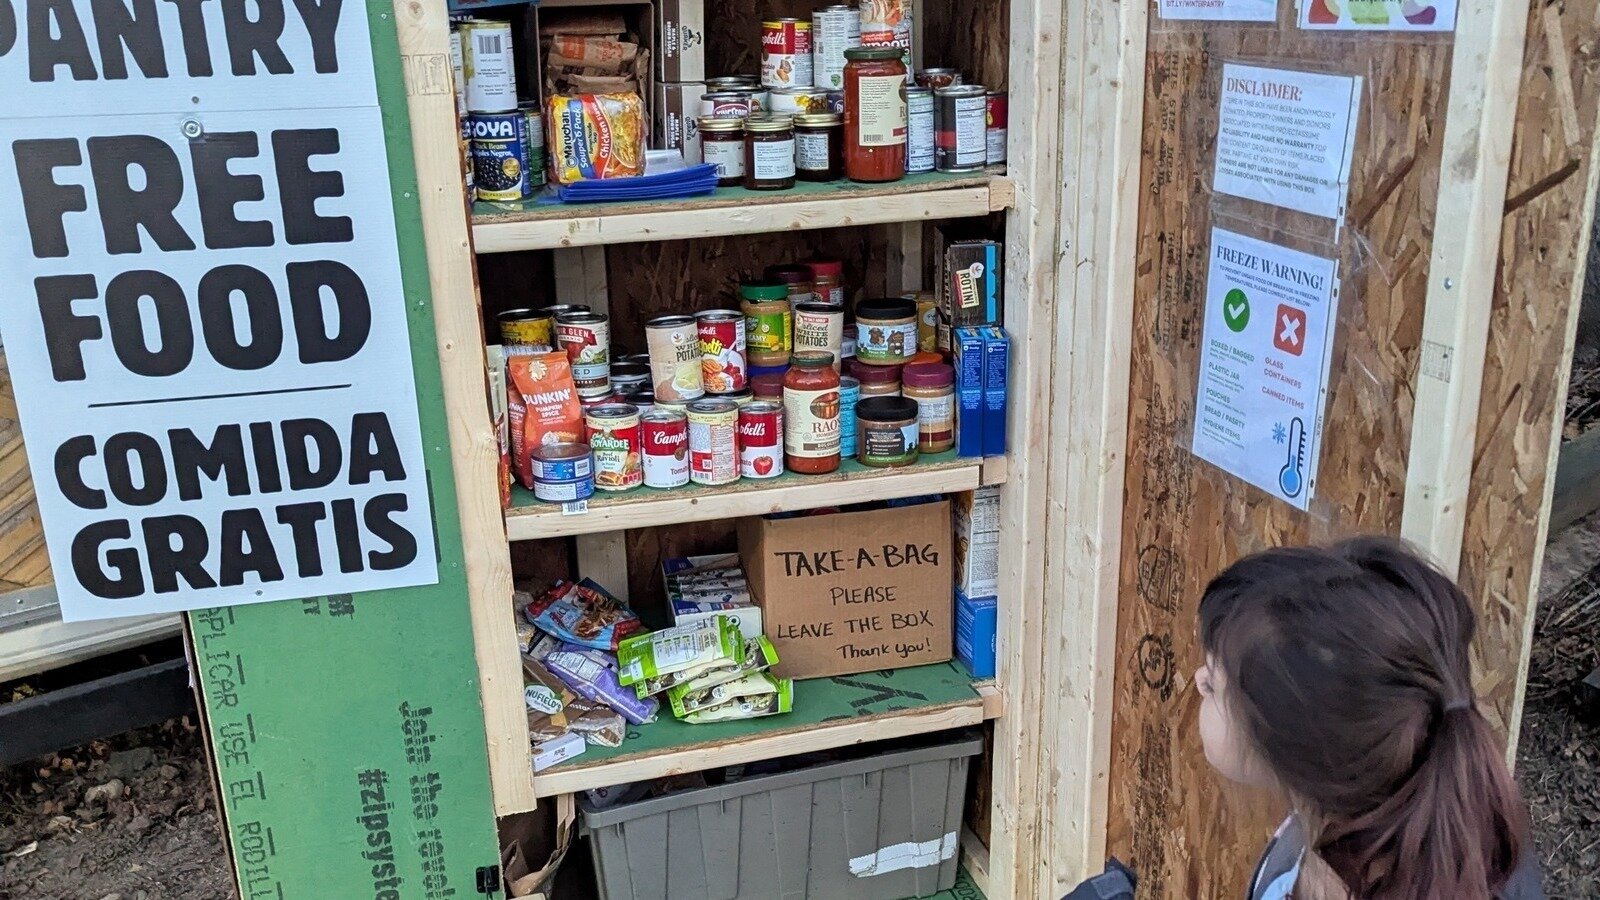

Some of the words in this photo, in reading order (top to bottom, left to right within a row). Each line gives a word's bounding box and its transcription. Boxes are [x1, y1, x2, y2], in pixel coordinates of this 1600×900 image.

[1226, 77, 1303, 102] DISCLAIMER:
[574, 106, 582, 129] Pack
[561, 109, 572, 158] Maruchan
[599, 122, 611, 159] Chicken
[1261, 135, 1275, 143] MAKE
[1284, 138, 1314, 150] WARRANTY
[577, 140, 589, 169] Souper
[1234, 170, 1263, 182] ASSOCIATED
[12, 127, 354, 258] FREE
[1216, 245, 1260, 271] FREEZE
[1261, 258, 1324, 291] WARNING!
[960, 272, 975, 305] ROTINI
[1255, 276, 1267, 285] FOOD
[33, 259, 371, 382] FOOD
[568, 328, 590, 338] GLEN
[795, 334, 828, 347] POTATOES
[1210, 338, 1228, 351] BOXED
[1232, 347, 1255, 363] BAGGED
[1208, 361, 1230, 376] PLASTIC
[1230, 370, 1240, 381] JAR
[1264, 356, 1284, 370] GLASS
[1263, 368, 1302, 390] CONTAINERS
[521, 388, 571, 405] DUNKIN'
[1206, 387, 1230, 404] POUCHES
[1261, 385, 1286, 402] CANNED
[1286, 394, 1305, 410] ITEMS
[535, 403, 563, 412] PUMPKIN
[541, 410, 559, 418] SPICE
[1204, 404, 1221, 418] BREAD
[590, 438, 630, 450] BOYARDEE
[653, 427, 688, 445] Campb
[1225, 427, 1241, 441] ITEMS
[54, 411, 407, 510] COMIDA
[70, 492, 418, 600] GRATIS
[773, 543, 939, 577] TAKE-A-BAG
[829, 585, 898, 606] PLEASE
[777, 622, 834, 639] LEAVE
[843, 615, 884, 634] THE
[891, 609, 934, 630] BOX
[836, 643, 890, 659] Thank
[218, 721, 250, 768] USE
[228, 779, 255, 810] EL
[408, 772, 443, 820] the
[355, 768, 405, 900] #zipsyste
